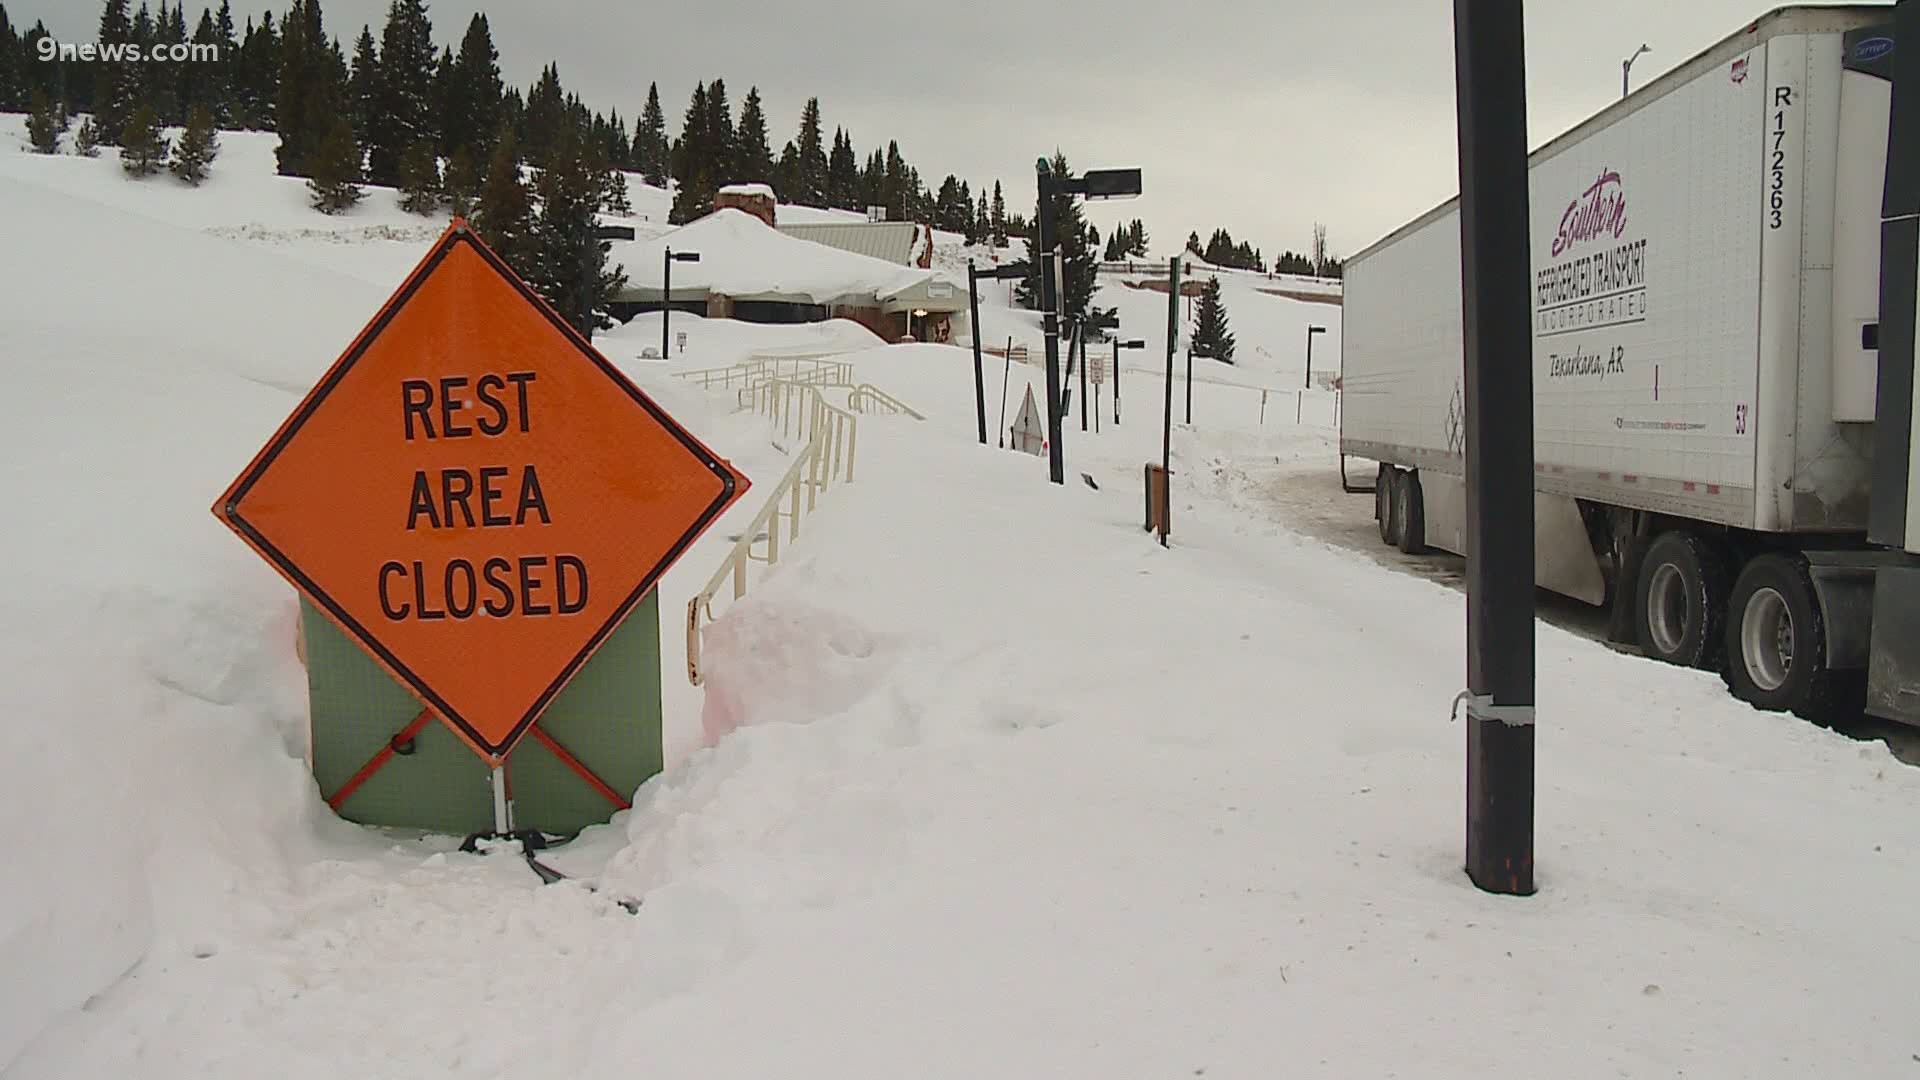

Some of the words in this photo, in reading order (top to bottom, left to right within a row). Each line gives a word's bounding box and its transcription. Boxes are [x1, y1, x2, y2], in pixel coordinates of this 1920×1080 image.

[1770, 86, 1791, 229] R172363
[1552, 167, 1627, 257] Southern
[1537, 256, 1591, 306] REFRIGERATED
[1593, 239, 1646, 294] TRANSPORT
[1536, 291, 1646, 331] INCORPORATED
[1550, 345, 1605, 382] Texarkana,
[1607, 345, 1625, 374] AR
[402, 372, 536, 440] REST
[407, 465, 551, 530] AREA
[378, 555, 588, 621] CLOSED
